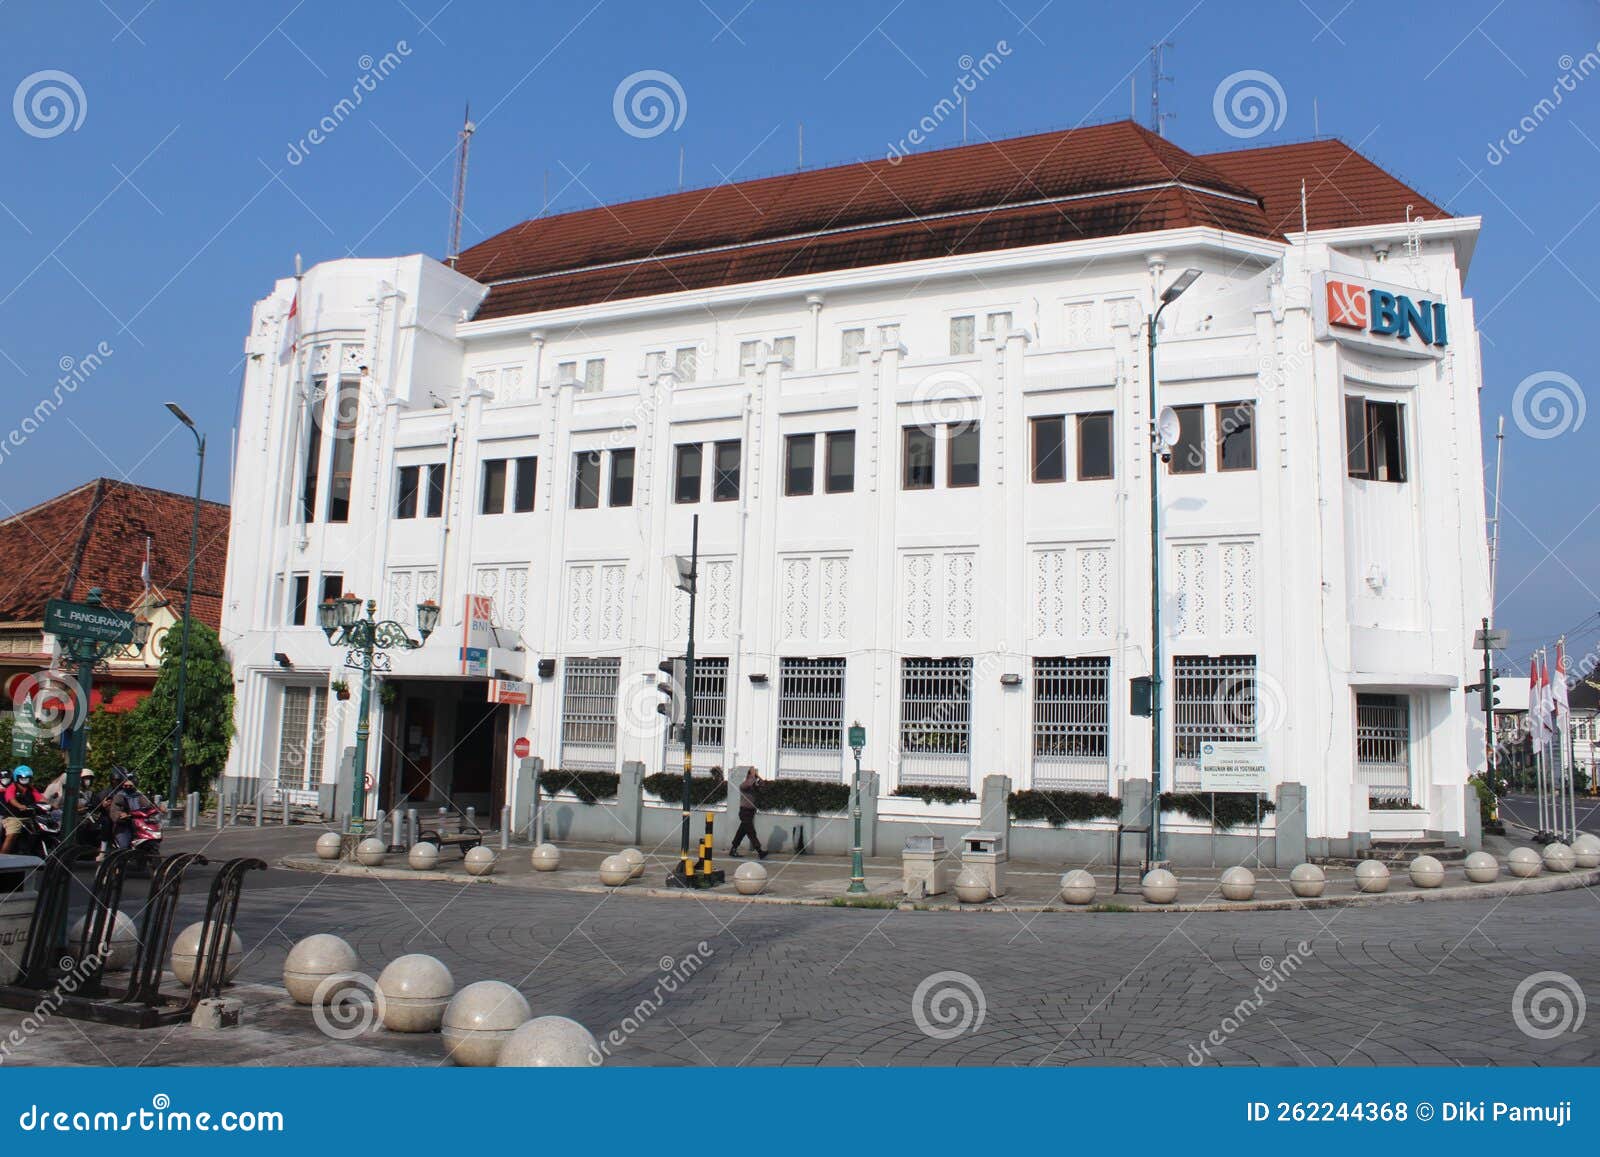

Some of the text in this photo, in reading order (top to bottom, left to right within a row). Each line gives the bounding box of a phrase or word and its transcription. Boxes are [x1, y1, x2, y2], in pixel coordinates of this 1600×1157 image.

[1368, 289, 1448, 346] BNI
[70, 611, 132, 629] PANGURAKAN
[472, 620, 488, 632] BNI
